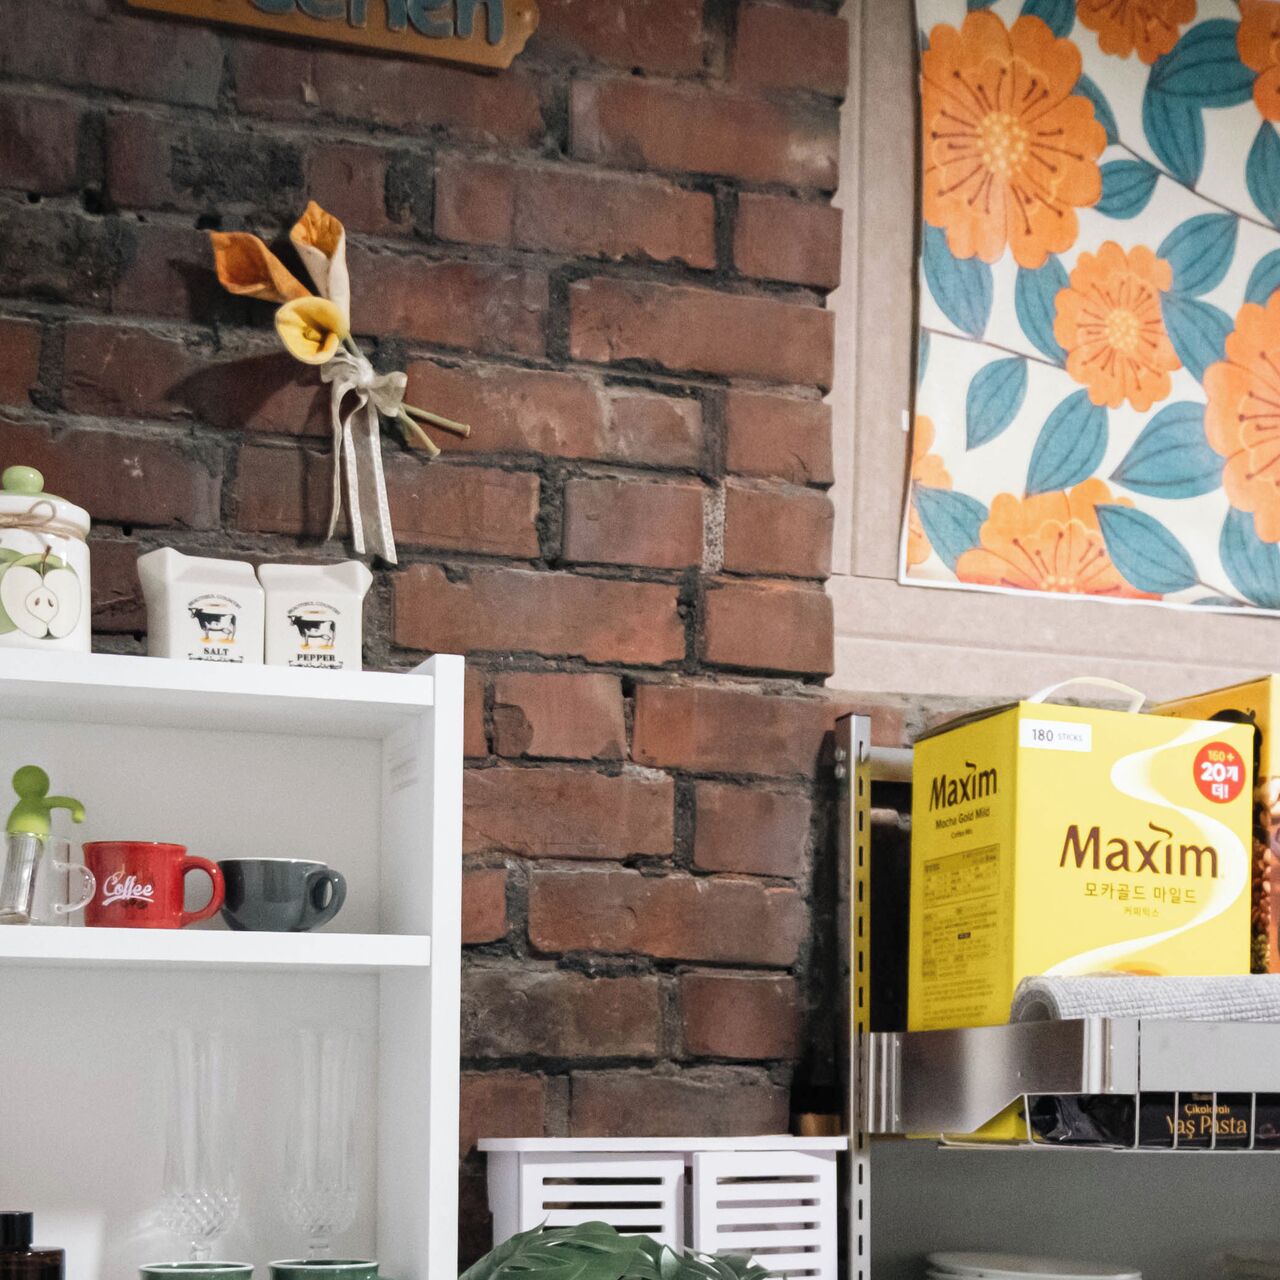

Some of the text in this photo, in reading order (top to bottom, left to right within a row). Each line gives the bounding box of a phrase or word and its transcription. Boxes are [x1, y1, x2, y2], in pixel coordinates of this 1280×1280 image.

[203, 647, 229, 656] SALT
[296, 653, 336, 662] PEPPER
[1031, 728, 1054, 742] 180
[1200, 761, 1239, 783] 20개
[928, 762, 998, 813] Maxim
[959, 811, 974, 824] Gold
[1059, 821, 1218, 879] Maxim
[102, 873, 154, 902] Coffee
[1084, 882, 1197, 904] 모카골드 마일드
